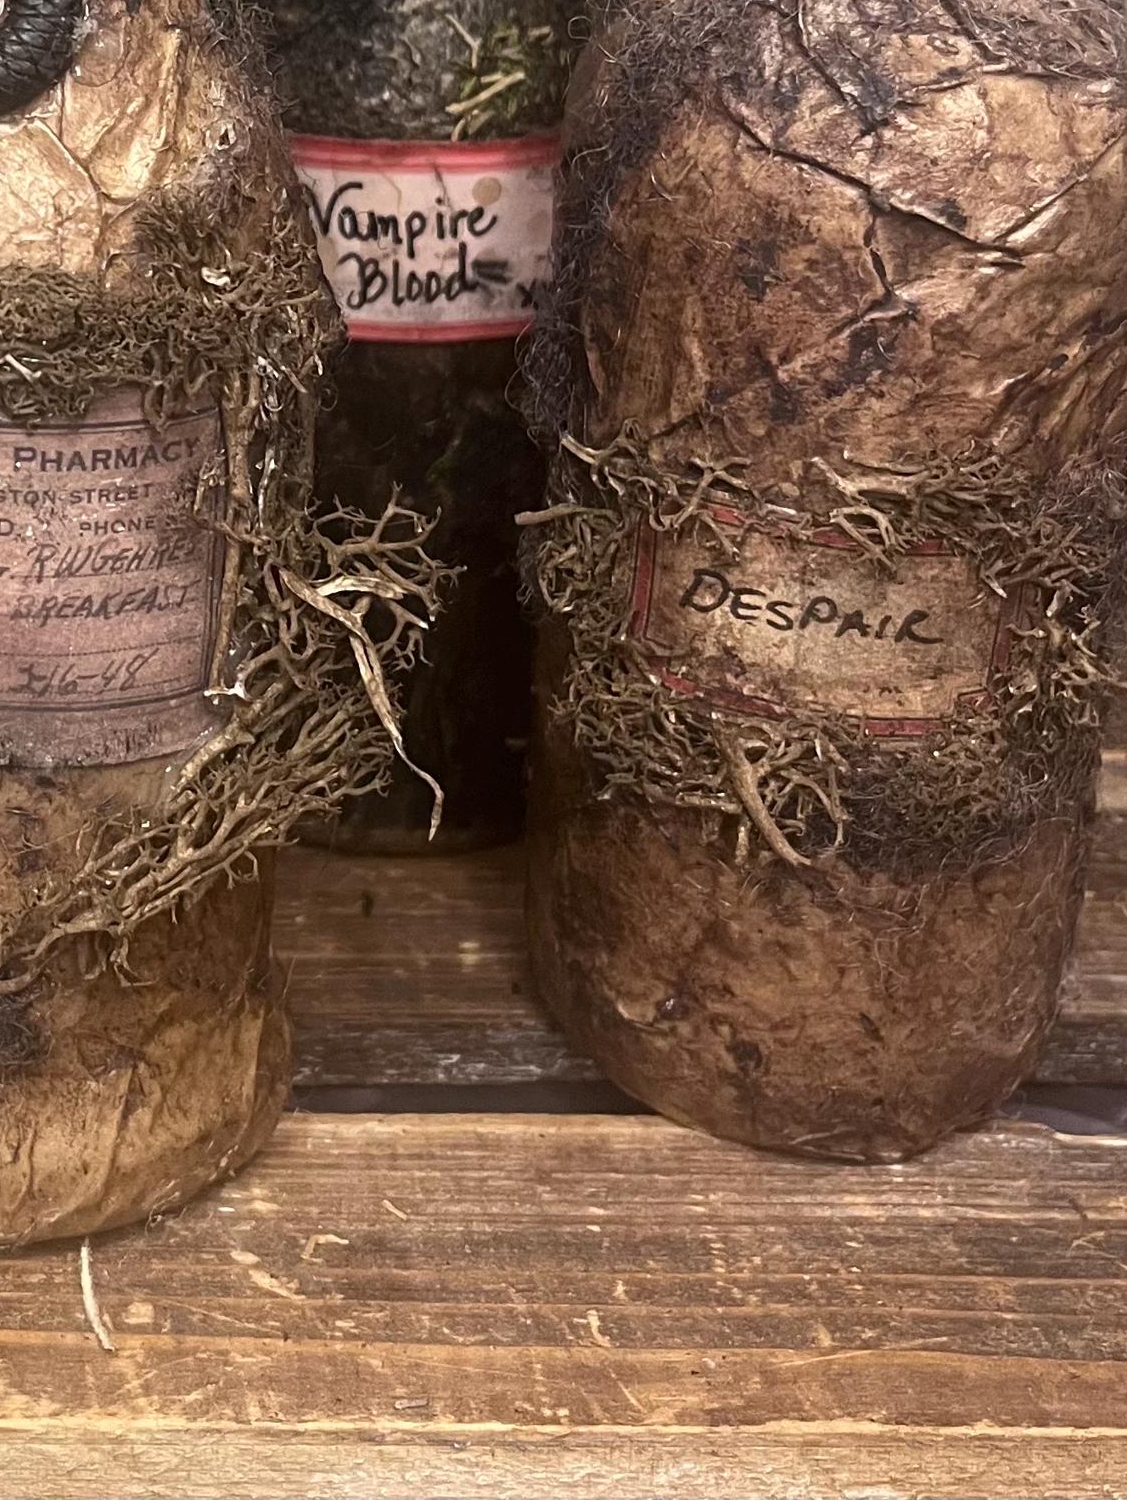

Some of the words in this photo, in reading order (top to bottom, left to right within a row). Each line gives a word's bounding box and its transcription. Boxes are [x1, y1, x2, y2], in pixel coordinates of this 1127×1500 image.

[302, 181, 498, 259] Vampire
[336, 241, 485, 310] Blood
[13, 437, 201, 473] PHARMACY
[69, 482, 153, 504] STREET
[79, 515, 157, 538] PHONE
[10, 579, 202, 628] BREAKFAST
[679, 567, 944, 645] DESPAIR
